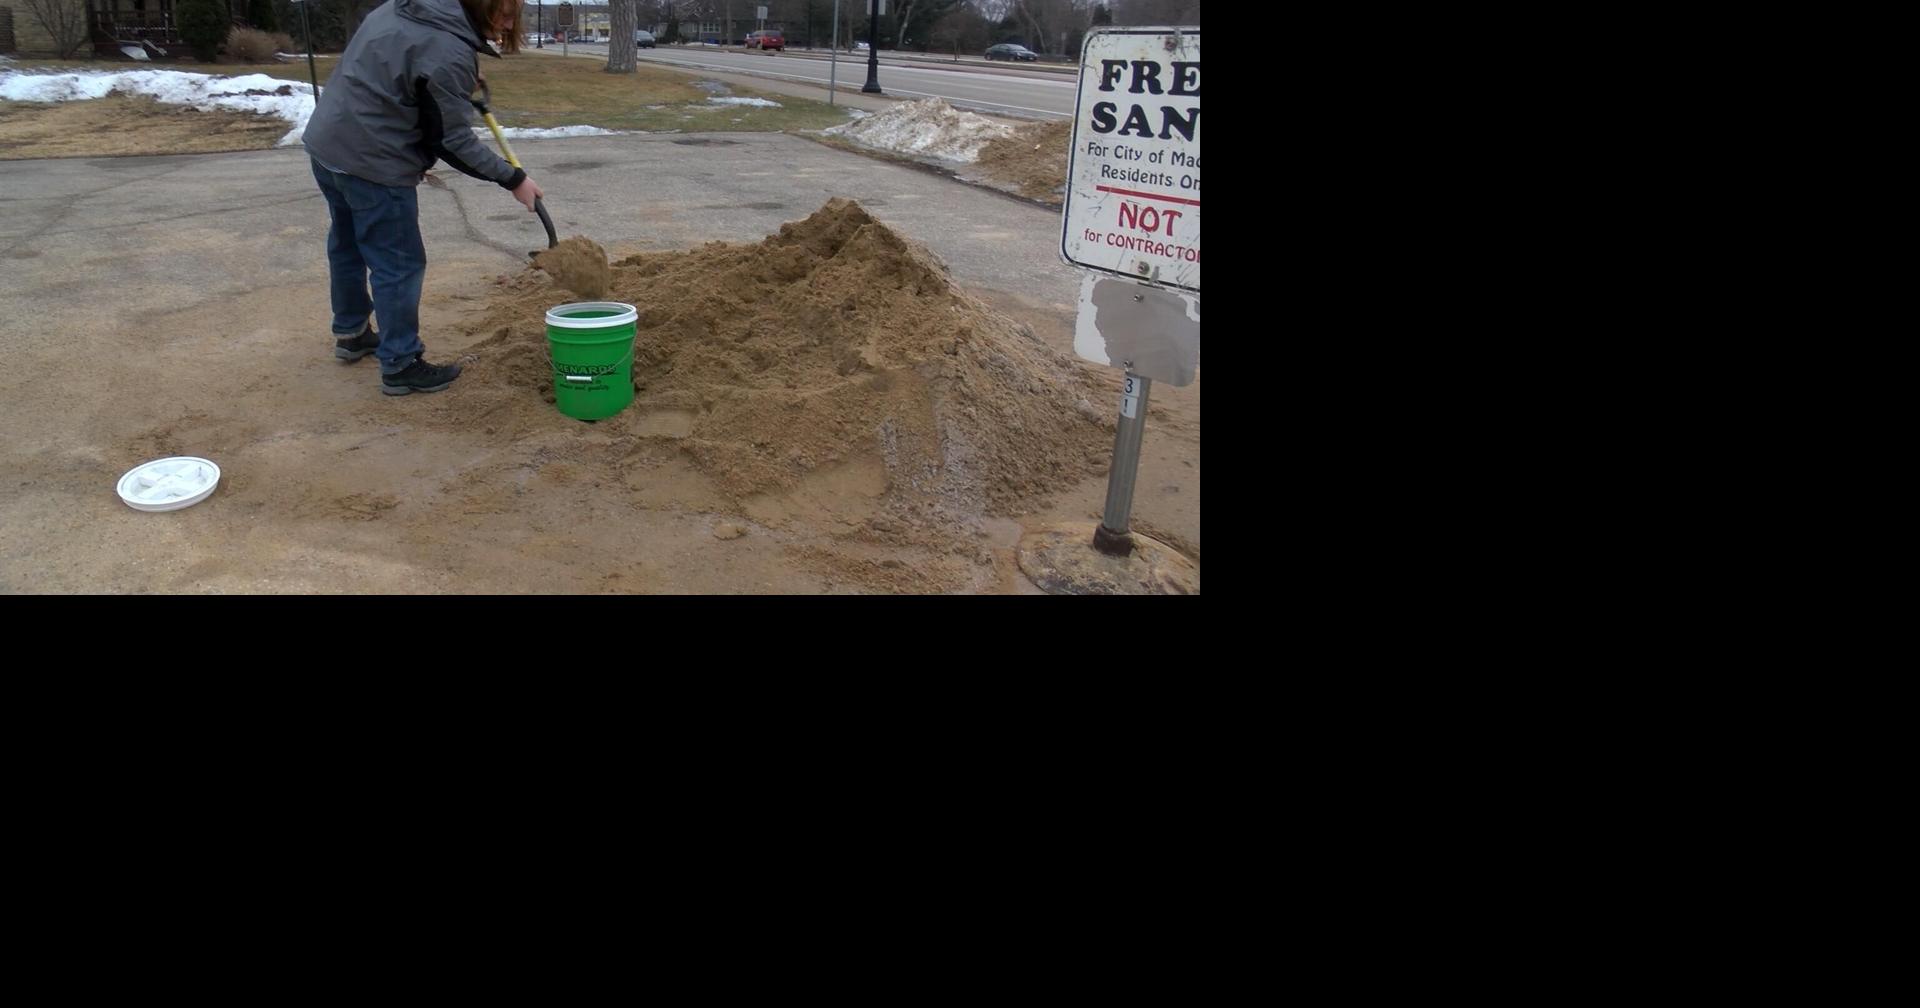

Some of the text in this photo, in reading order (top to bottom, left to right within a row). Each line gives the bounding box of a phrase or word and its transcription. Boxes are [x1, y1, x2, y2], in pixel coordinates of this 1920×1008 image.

[1088, 142, 1109, 157] For
[1114, 145, 1142, 161] City
[1149, 150, 1164, 164] of
[1101, 164, 1173, 187] Residents
[1118, 202, 1183, 236] NOT
[1084, 228, 1102, 243] for
[1125, 378, 1133, 393] 3
